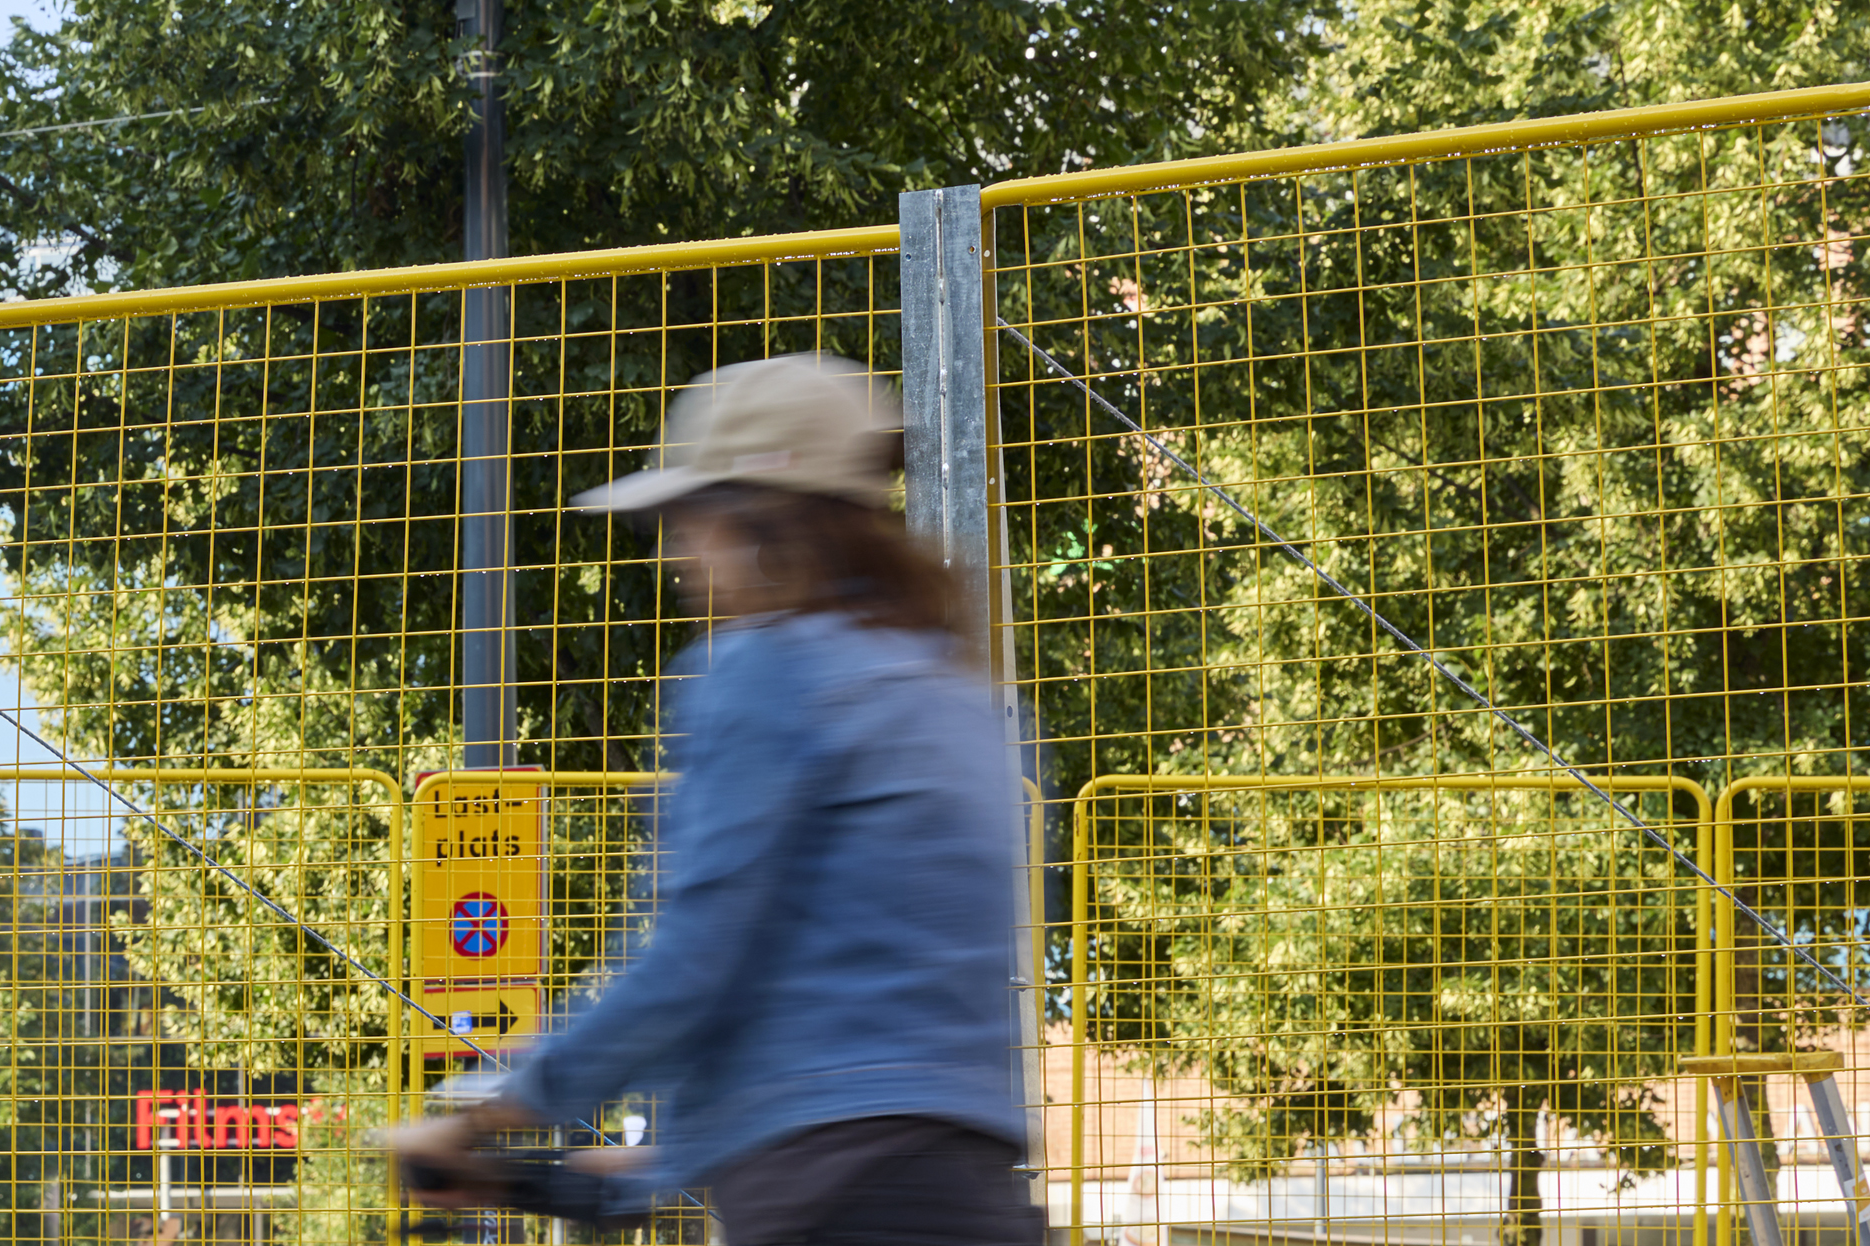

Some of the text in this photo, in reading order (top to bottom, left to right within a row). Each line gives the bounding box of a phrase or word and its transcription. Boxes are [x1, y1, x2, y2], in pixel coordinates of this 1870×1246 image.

[434, 788, 523, 818] Last-
[436, 829, 521, 867] plats
[136, 1088, 347, 1150] Films
